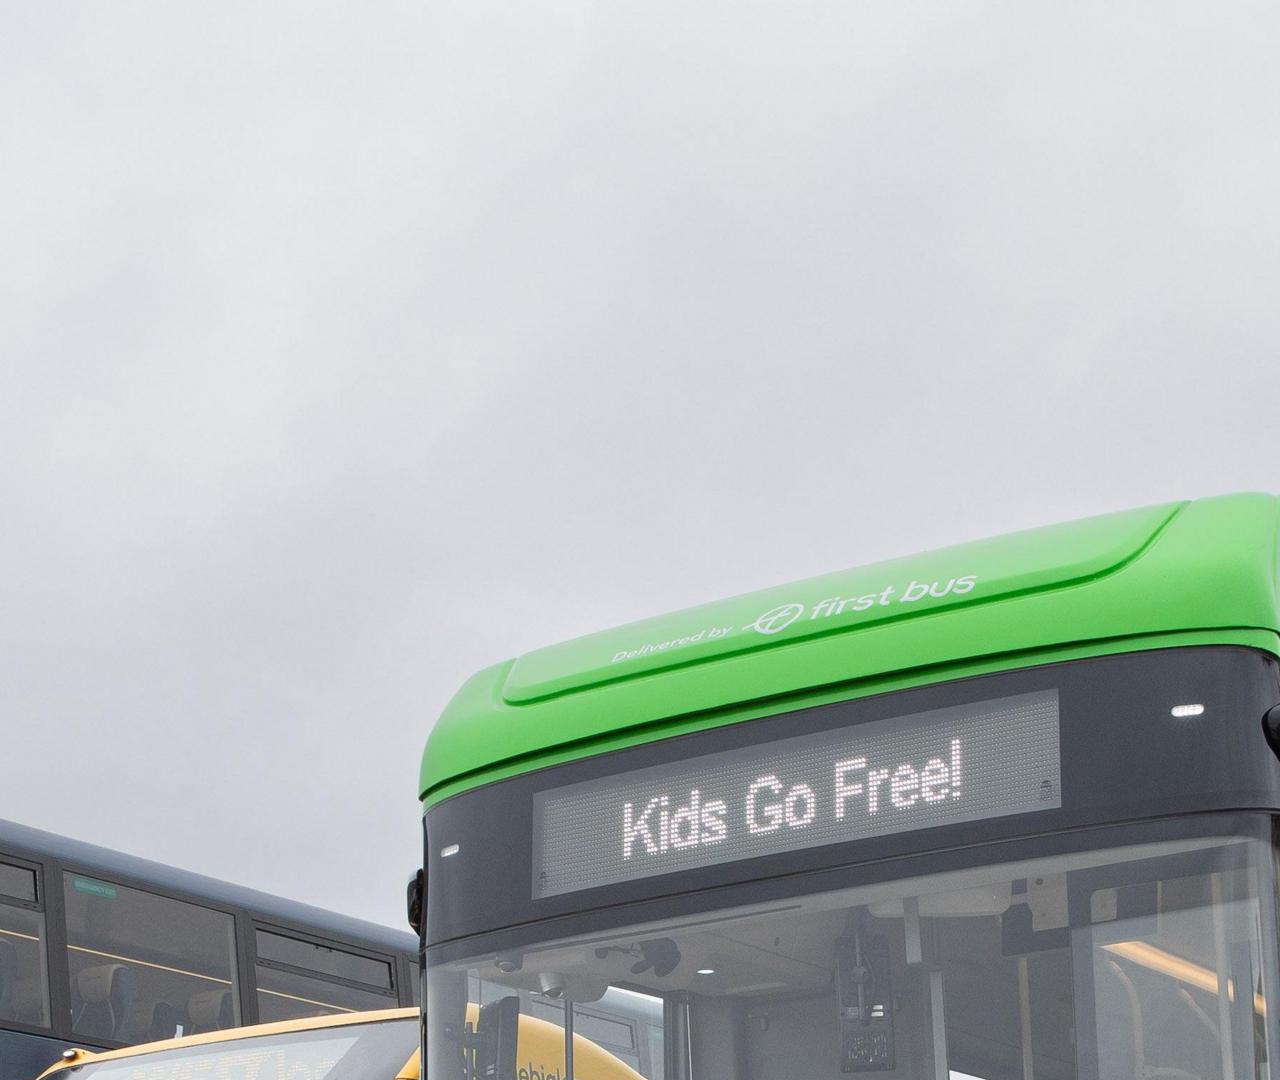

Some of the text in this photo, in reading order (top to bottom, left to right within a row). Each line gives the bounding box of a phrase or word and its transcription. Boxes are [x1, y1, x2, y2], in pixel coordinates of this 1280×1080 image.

[810, 575, 978, 620] first bus
[611, 624, 734, 663] Delivered by
[623, 738, 961, 860] Kids Go Free!
